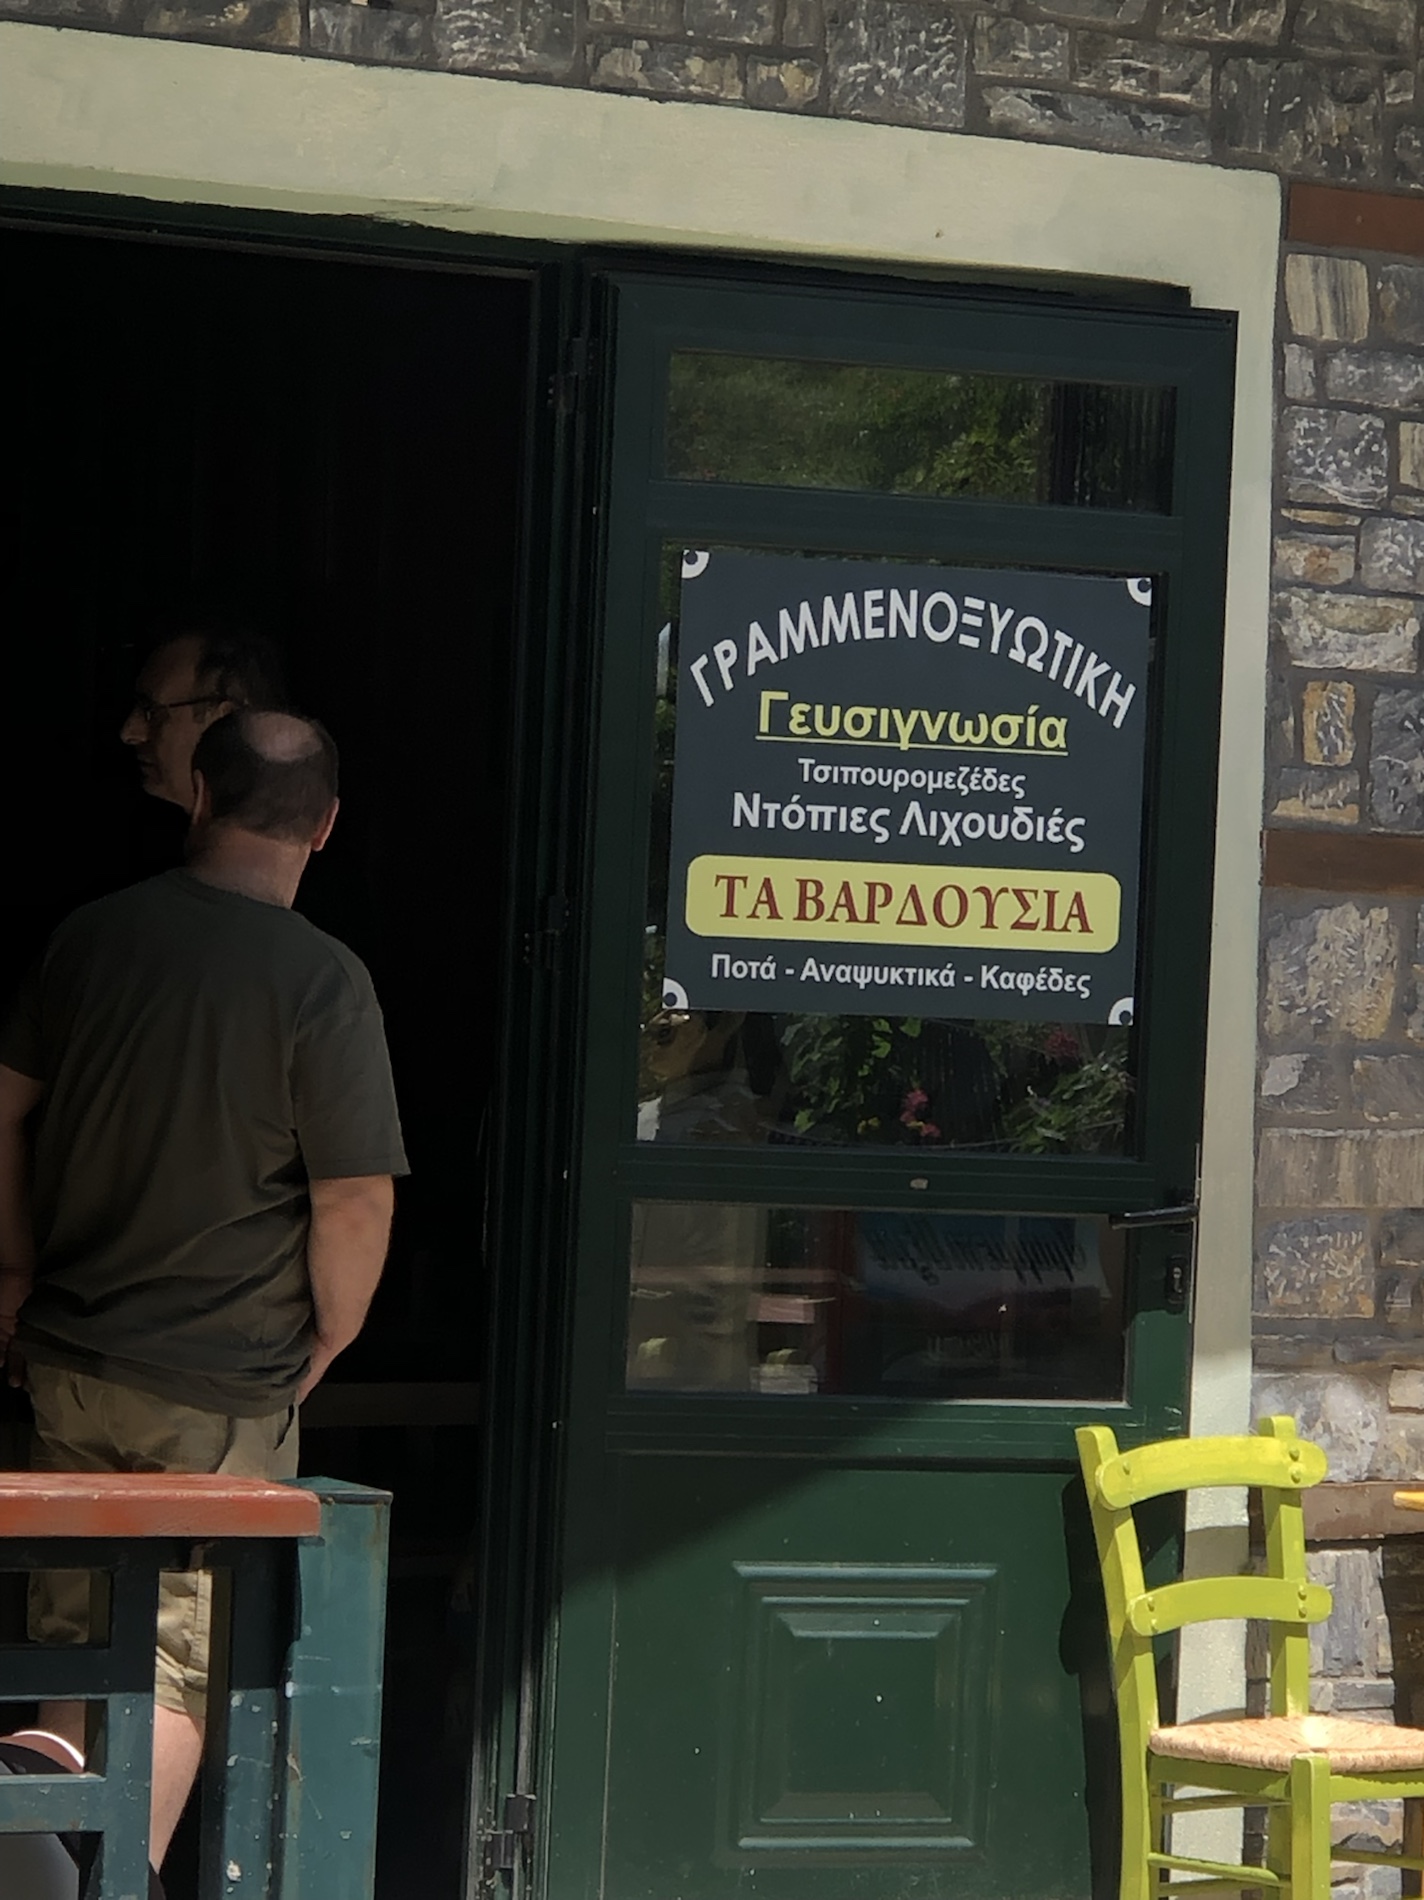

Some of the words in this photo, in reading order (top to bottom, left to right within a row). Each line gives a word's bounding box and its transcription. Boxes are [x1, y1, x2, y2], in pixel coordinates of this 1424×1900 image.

[689, 588, 1137, 729] ΓΡΑΜΜΕΝΟΞΥΩΤΙΚΗ
[758, 690, 1069, 751] Γευσιγνωσία
[797, 757, 1027, 800] Τσιπουρομεζέδες
[732, 791, 892, 844] Ντόπιες
[898, 800, 1087, 853] Λιχουδιές
[714, 874, 784, 921] ΤΑ
[792, 877, 1095, 935] ΒΑΡΔΟΥΣΙΑ
[710, 952, 777, 981] Ποτά
[799, 956, 957, 990] Αναψυκτικά
[979, 964, 1092, 1000] Καφέδες
